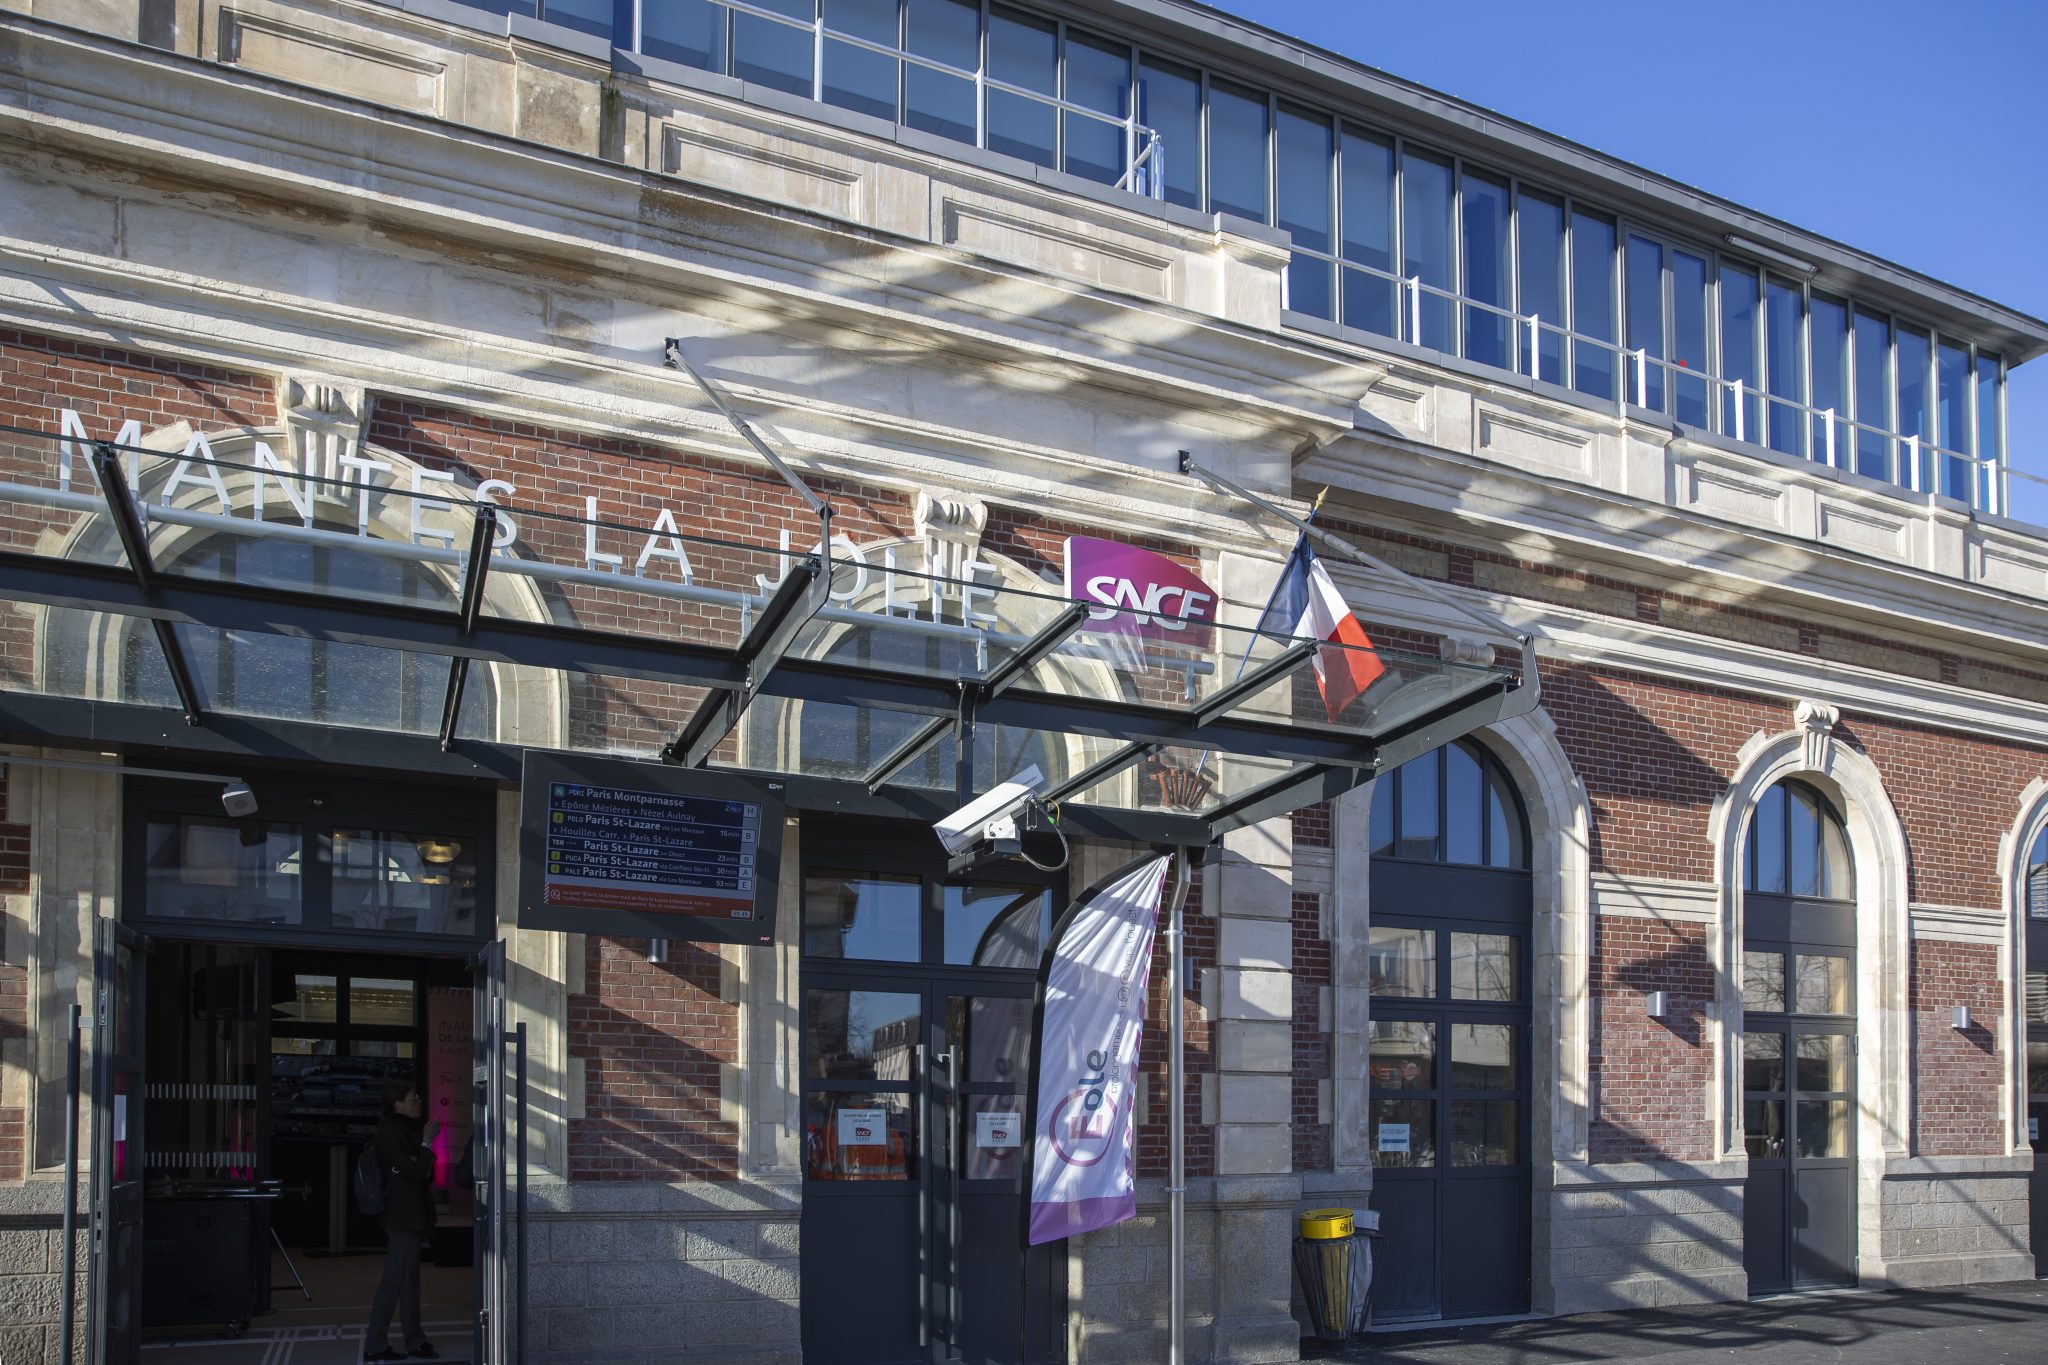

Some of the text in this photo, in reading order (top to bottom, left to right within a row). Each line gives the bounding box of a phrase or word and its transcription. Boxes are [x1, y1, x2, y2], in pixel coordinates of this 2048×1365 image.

[60, 408, 998, 622] MANTES LA JOLIE
[1086, 575, 1211, 631] SNCF
[586, 788, 611, 799] Paris
[614, 791, 685, 807] Montparnasse
[585, 814, 610, 825] Paris
[612, 817, 661, 830] St-Lazare
[667, 810, 696, 823] Aulnay
[560, 826, 597, 837] Houilles
[630, 832, 650, 842] Paris
[652, 835, 693, 846] St-Lazare
[584, 840, 608, 851] Paris
[611, 843, 659, 856] St-Lazare
[583, 853, 608, 864] Paris
[610, 856, 658, 869] St-Lazare
[582, 866, 607, 877] Paris
[609, 869, 658, 882] St-Lazare
[1069, 1049, 1108, 1139] Eole
